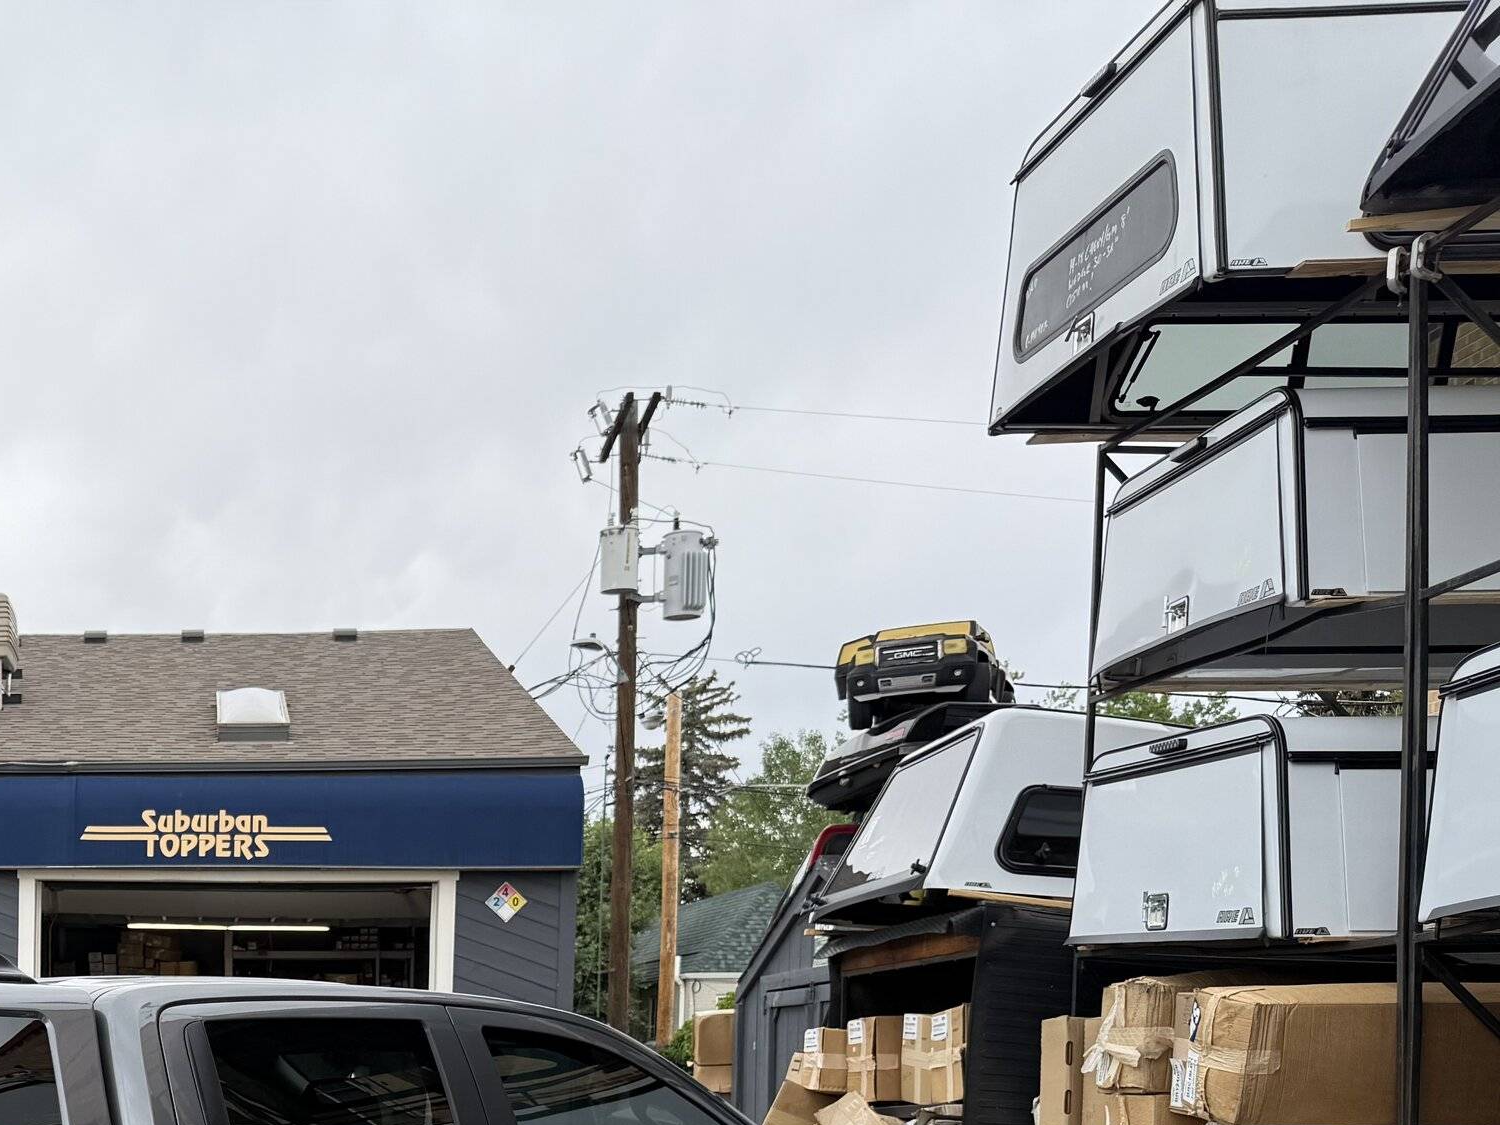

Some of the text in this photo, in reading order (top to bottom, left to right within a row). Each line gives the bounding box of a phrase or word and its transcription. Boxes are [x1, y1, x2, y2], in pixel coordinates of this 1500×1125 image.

[893, 650, 923, 659] GMC
[141, 809, 268, 833] Suburban
[144, 834, 270, 860] TOPPERS
[502, 887, 509, 897] 4
[493, 897, 500, 906] 2
[512, 896, 519, 906] 0
